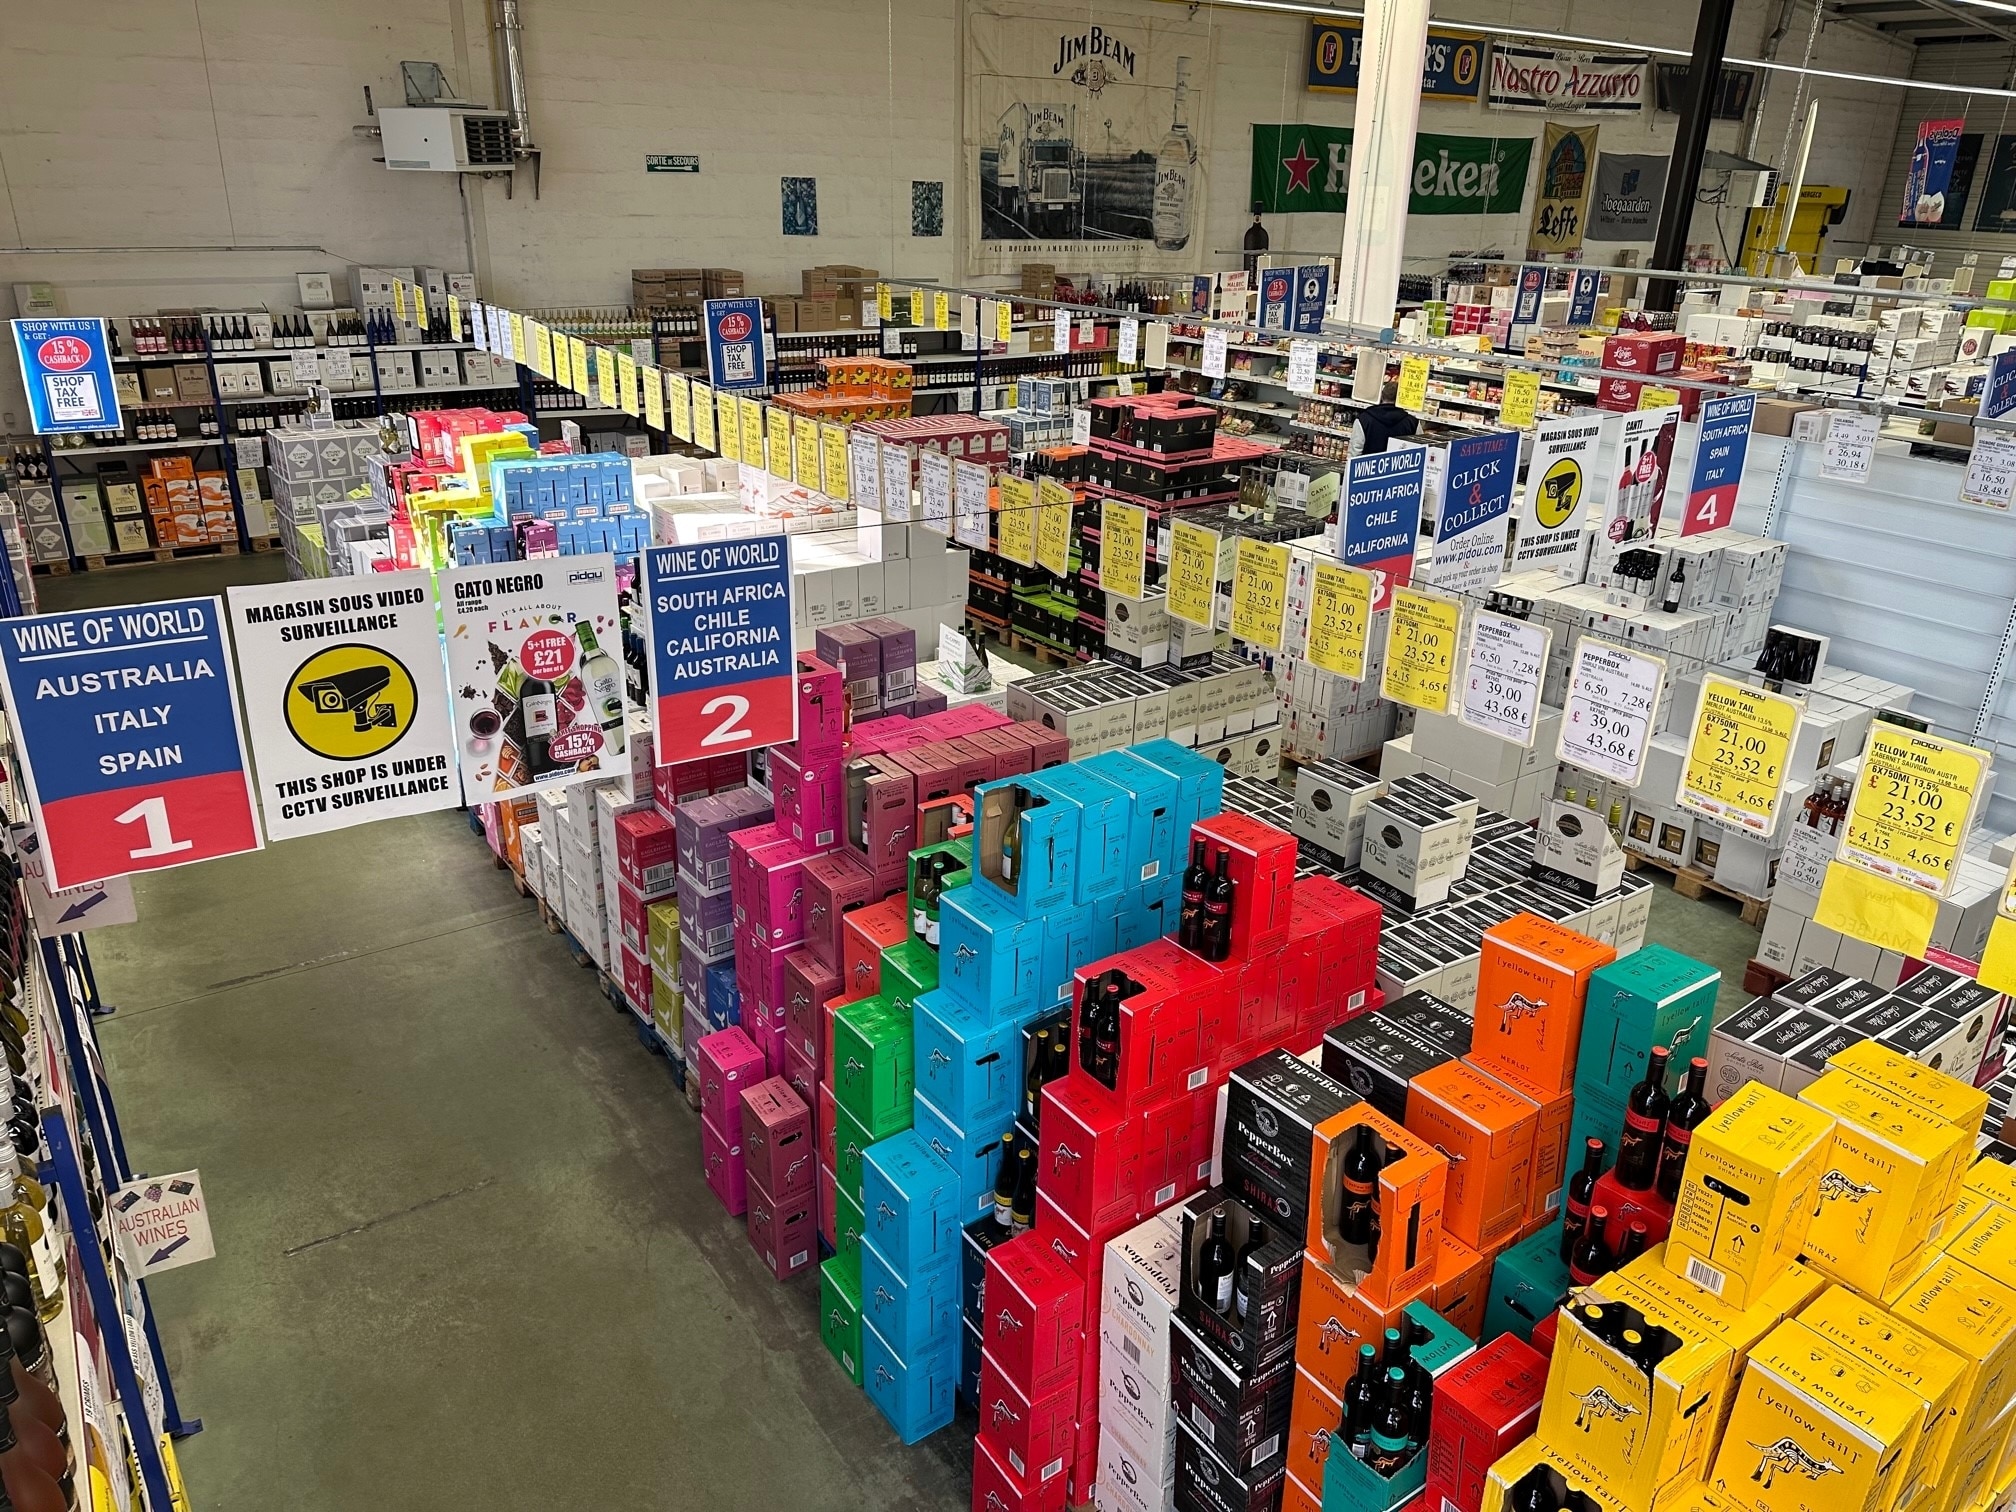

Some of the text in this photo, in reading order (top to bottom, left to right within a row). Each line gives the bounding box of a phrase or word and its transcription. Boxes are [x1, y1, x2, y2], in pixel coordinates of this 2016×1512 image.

[1053, 26, 1135, 77] JIM BEAM
[1492, 57, 1641, 98] Nastro Azzurro
[646, 156, 667, 166] SORTIE
[673, 156, 698, 166] SECOURS
[1324, 143, 1500, 198] Heken
[1156, 168, 1186, 189] JIM BEAM
[1536, 204, 1578, 243] Leffe
[711, 302, 727, 310] SHOP
[22, 322, 90, 332] SHOP WITH US
[728, 317, 735, 327] 15
[52, 340, 78, 354] 15 %
[727, 345, 746, 353] SHOP
[44, 355, 81, 364] CASHBACK
[728, 362, 745, 370] FREE
[53, 377, 85, 387] SHOP
[55, 387, 78, 397] TAX
[57, 397, 85, 407] FREE
[1707, 400, 1751, 418] WINE OF WORLD
[1541, 426, 1599, 443] MAGASIN SOUS VIDEO
[1626, 419, 1643, 431] CANTI
[1701, 424, 1748, 442] SOUTH AFRICA
[1460, 440, 1503, 457] SAVE TIME
[1548, 441, 1587, 455] SURVEILLANCE
[1709, 446, 1730, 460] SPAIN
[1838, 449, 1861, 458] 26,94
[1354, 452, 1421, 478] WINE OF WORLD
[1452, 458, 1501, 490] CLICK
[1640, 462, 1652, 475] FREE
[1705, 467, 1725, 481] ITALY
[1981, 473, 2005, 485] 16,50
[1350, 482, 1420, 507] SOUTH AFRICA
[1469, 483, 1482, 505] &
[1366, 510, 1397, 527] CHILE
[1444, 494, 1505, 533] COLLECT
[1696, 494, 1717, 525] 4
[1347, 532, 1409, 557] CALIFORNIA
[1450, 532, 1495, 551] Order Online
[1520, 529, 1580, 548] THIS SHOP IS UNDER
[656, 542, 779, 575] WINE OF WORLD
[1435, 543, 1503, 566] www.pidou.com
[1517, 542, 1577, 561] CCTV SURVEILLANCE
[454, 573, 544, 600] GATO NEGRO
[569, 570, 603, 583] pidou
[245, 588, 424, 624] MAGASIN SOUS VIDEO
[474, 604, 489, 612] each
[657, 581, 785, 613] SOUTH AFRICA
[502, 607, 517, 617] IT'S
[535, 603, 562, 611] ABOUT
[694, 609, 750, 631] CHILE
[13, 607, 205, 653] WINE OF WORLD
[280, 613, 398, 642] SURVEILLANCE
[488, 612, 577, 633] FLAVOR
[1324, 615, 1353, 633] 23,52
[1478, 624, 1510, 638] PEPPERBOX
[527, 636, 566, 650] 5+1 FREE
[666, 626, 780, 657] CALIFORNIA
[533, 649, 563, 667] £21
[674, 649, 780, 680] AUSTRALIA
[1583, 652, 1620, 669] PEPPERBOX
[35, 658, 215, 700] AUSTRALIA
[1706, 701, 1756, 721] MERLOT AUSTRALIEN
[1708, 692, 1754, 713] YELLOW TAIL
[94, 705, 171, 734] ITALY
[700, 695, 753, 747] 2
[1590, 714, 1630, 737] 39,00
[566, 732, 595, 749] 15%
[1720, 728, 1766, 755] 21,00
[99, 745, 183, 775] SPAIN
[555, 748, 591, 759] CASHBACK
[1715, 748, 1760, 774] 23,52
[1873, 741, 1928, 765] YELLOW TAIL
[1871, 750, 1957, 781] CABERNET SAUVIGNON AUSTR
[275, 755, 447, 799] THIS SHOP IS UNDER
[1872, 765, 1939, 793] 6X750ML 13,5%
[281, 776, 448, 819] CCTV SURVEILLANCE
[1888, 780, 1943, 810] 21,00
[113, 796, 193, 859] 1
[1882, 802, 1936, 832] 23,52
[1538, 833, 1550, 846] 10
[1859, 831, 1889, 850] 4,15
[1907, 850, 1939, 868] 4,65
[1500, 1054, 1530, 1073] MERLOT
[1276, 1053, 1345, 1098] PepperBox
[1238, 1121, 1293, 1167] PepperBox
[1244, 1178, 1280, 1213] SHIRAZ
[118, 1198, 200, 1235] AUSTRALIAN
[133, 1221, 188, 1248] WINES
[1113, 1286, 1156, 1334] PepperBox
[1111, 1310, 1155, 1358] CHARDONNAY
[1181, 1355, 1227, 1408] PepperBox
[1575, 1453, 1609, 1482] SHIRAZ
